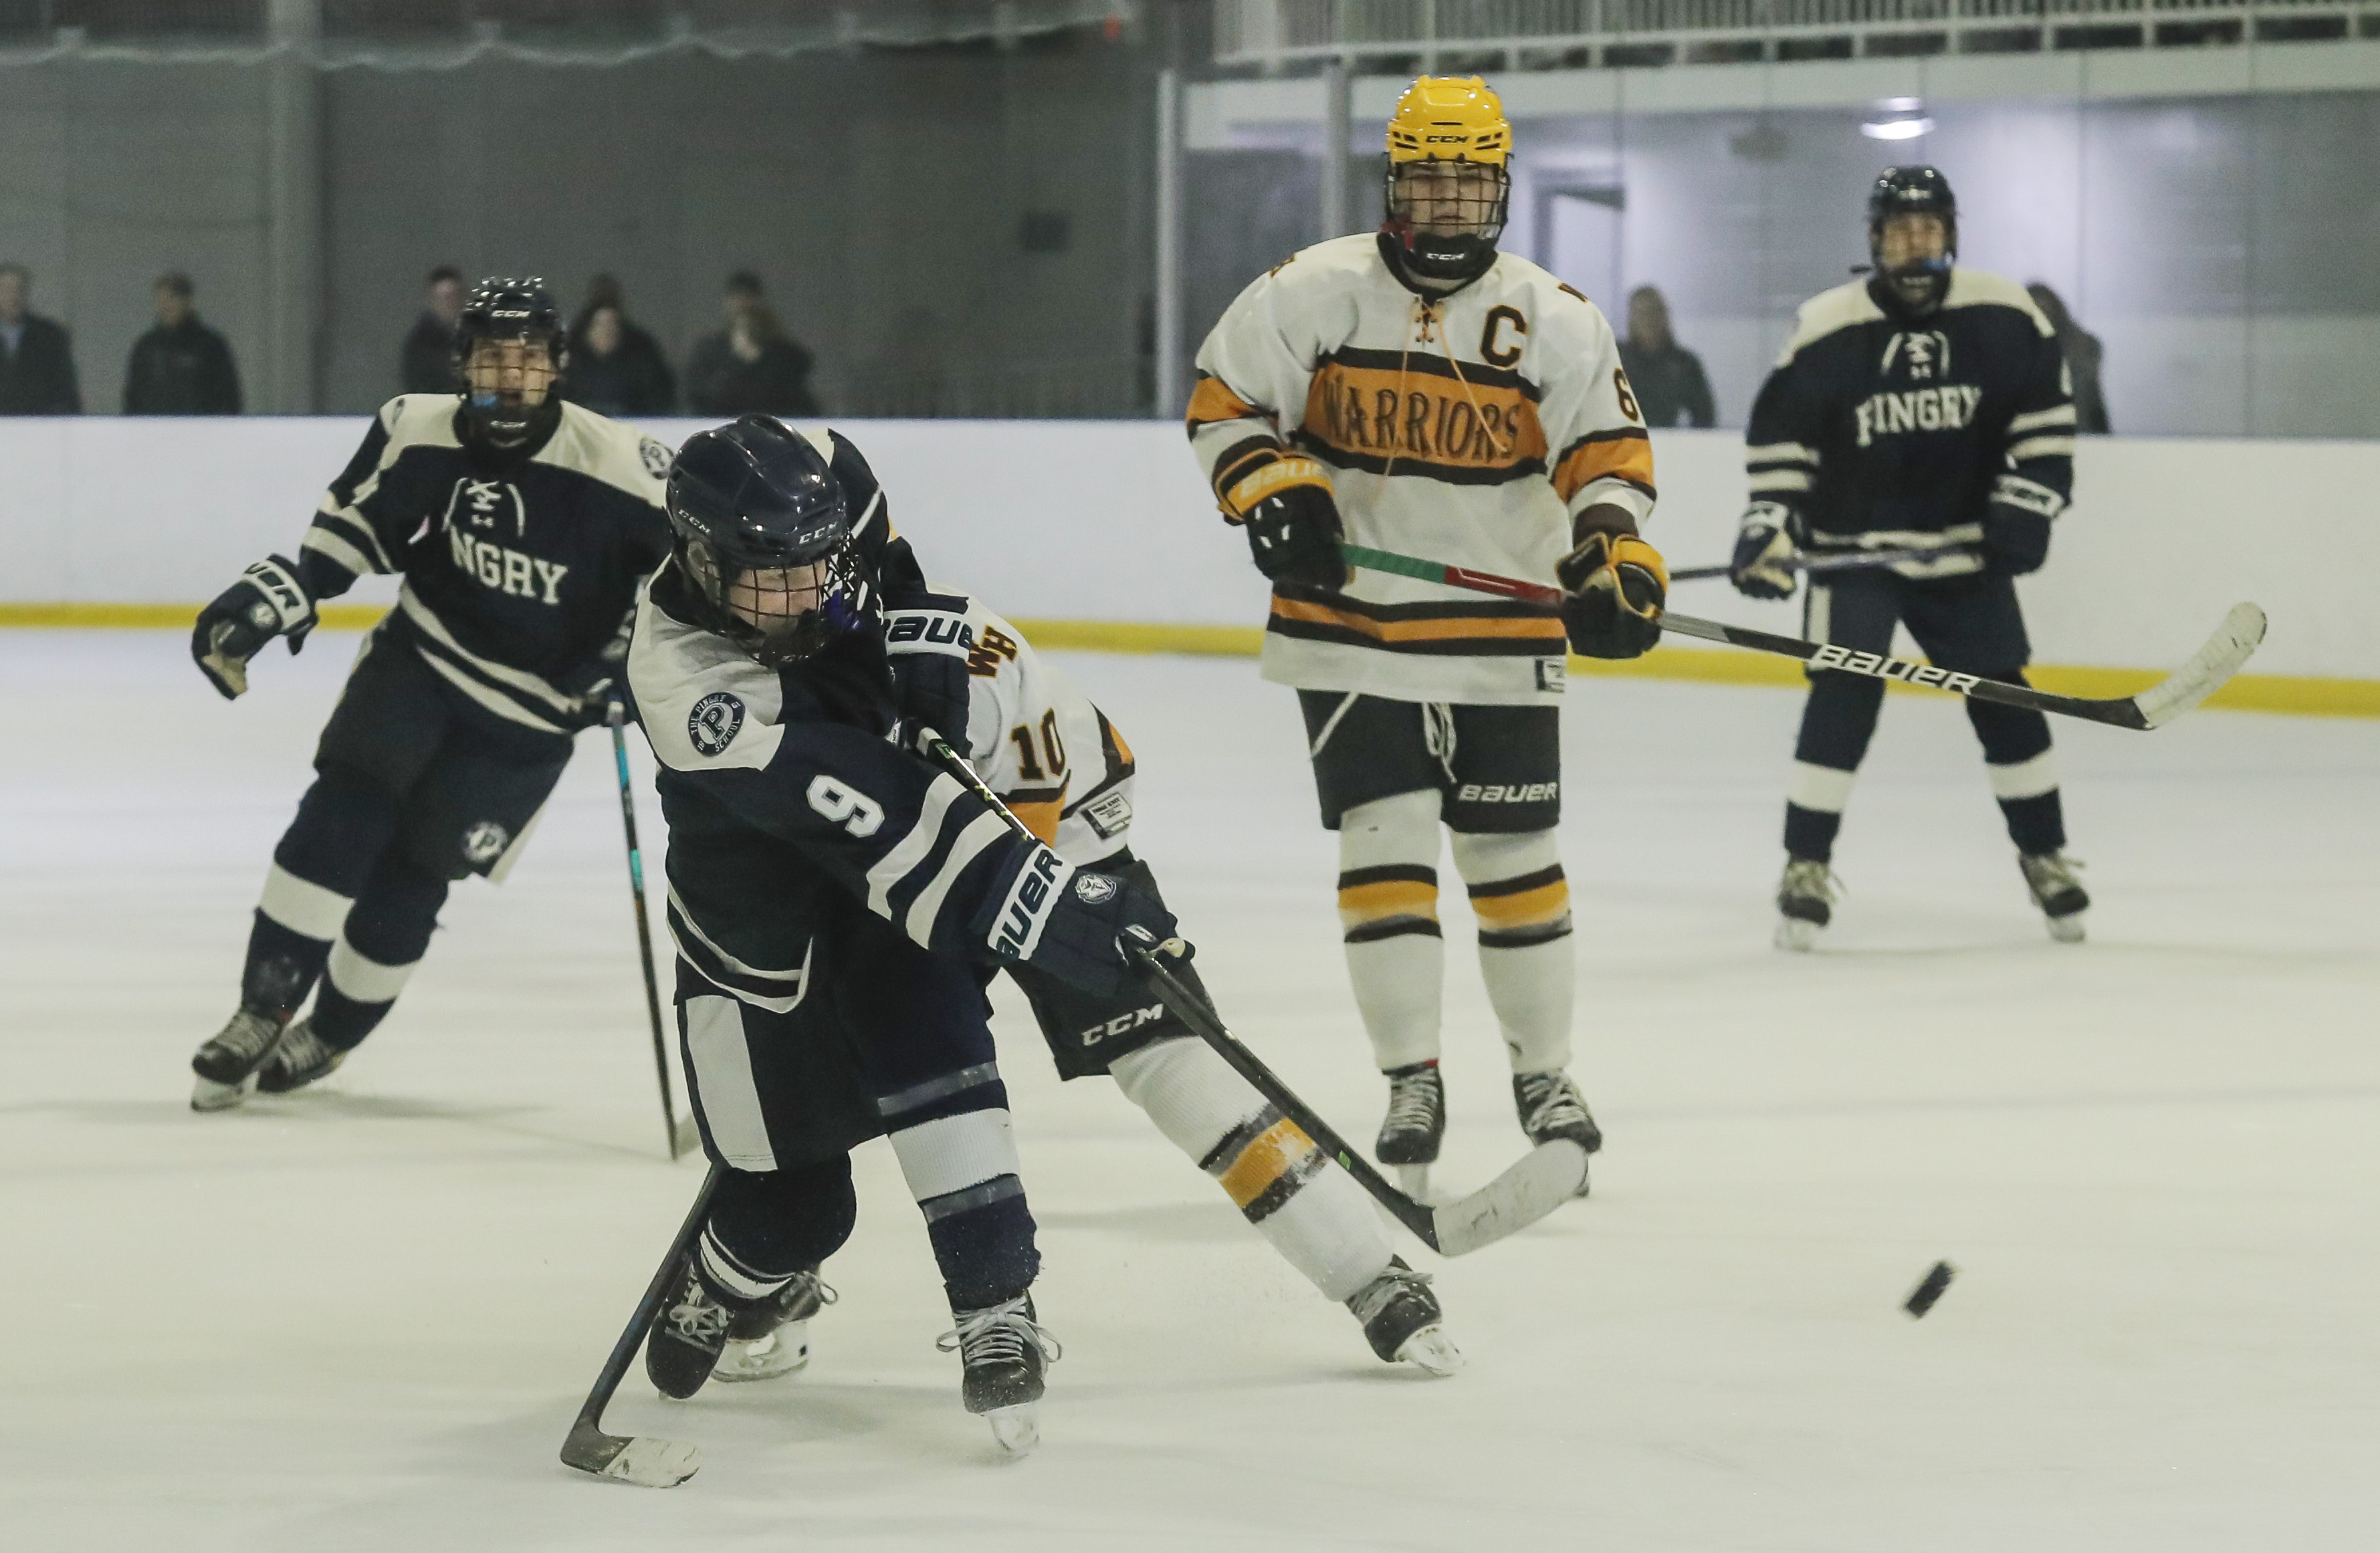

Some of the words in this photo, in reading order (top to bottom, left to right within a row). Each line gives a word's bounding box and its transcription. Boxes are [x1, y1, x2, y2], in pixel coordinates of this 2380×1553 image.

[1480, 305, 1527, 370] C
[1323, 372, 1521, 464] WARRIORS
[715, 719, 740, 752] SCHOOL
[1010, 706, 1066, 782] 10
[806, 774, 885, 838] 9
[1081, 1003, 1164, 1046] CCM
